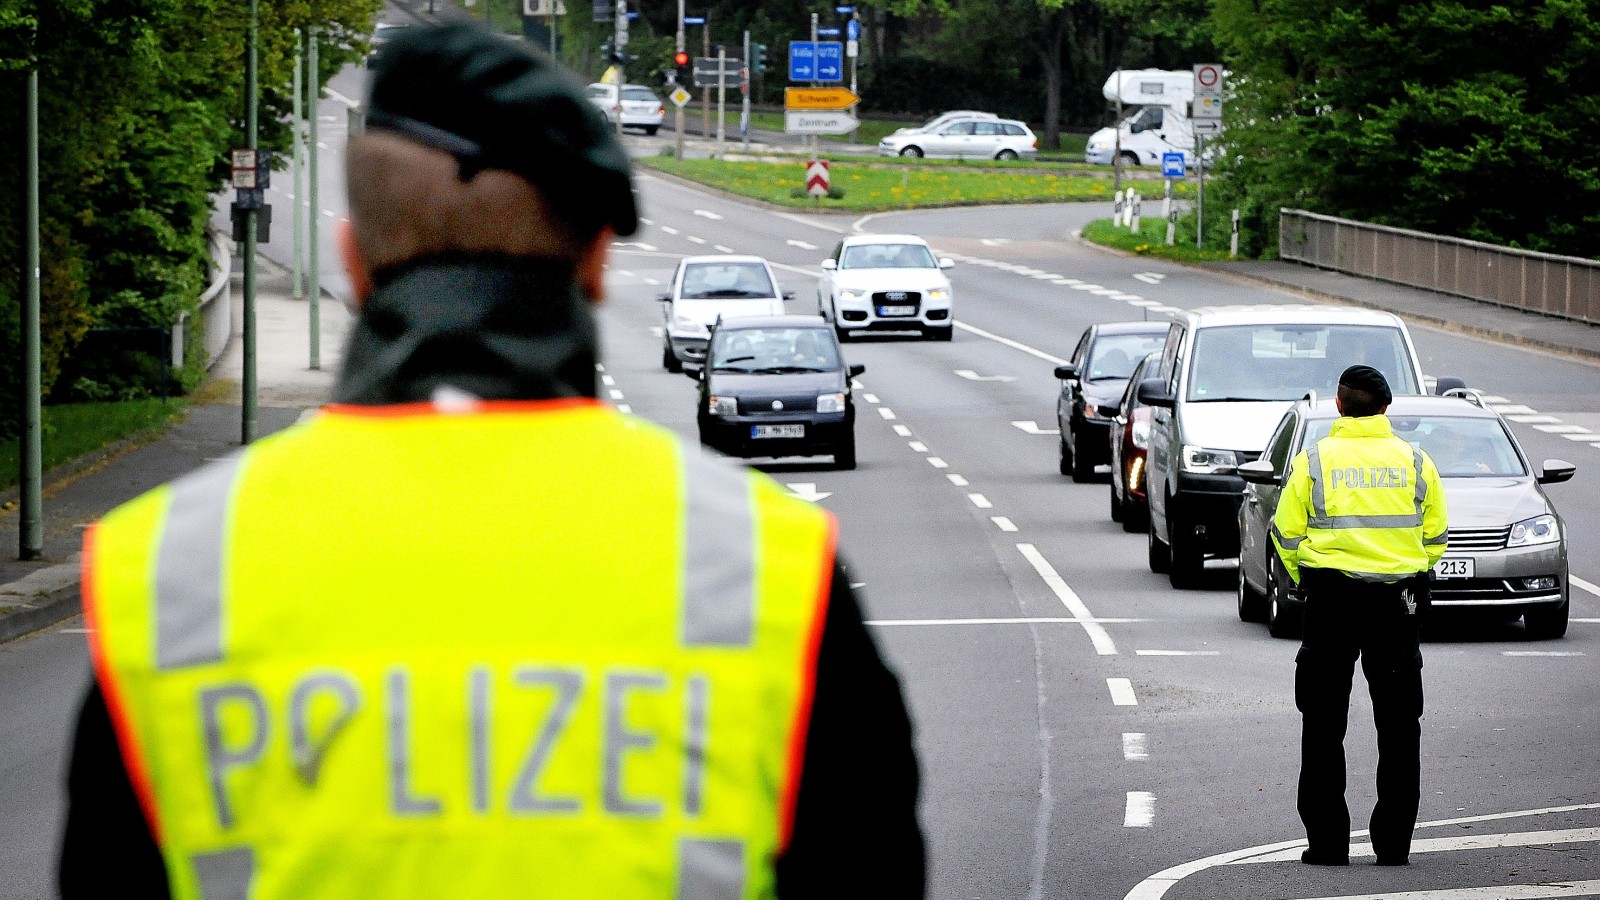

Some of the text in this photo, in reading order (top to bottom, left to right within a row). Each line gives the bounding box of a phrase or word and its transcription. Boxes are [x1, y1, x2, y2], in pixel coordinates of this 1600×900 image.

[1331, 467, 1407, 489] POLIZEI
[1440, 561, 1467, 575] 213
[200, 668, 710, 829] POLIZEI
